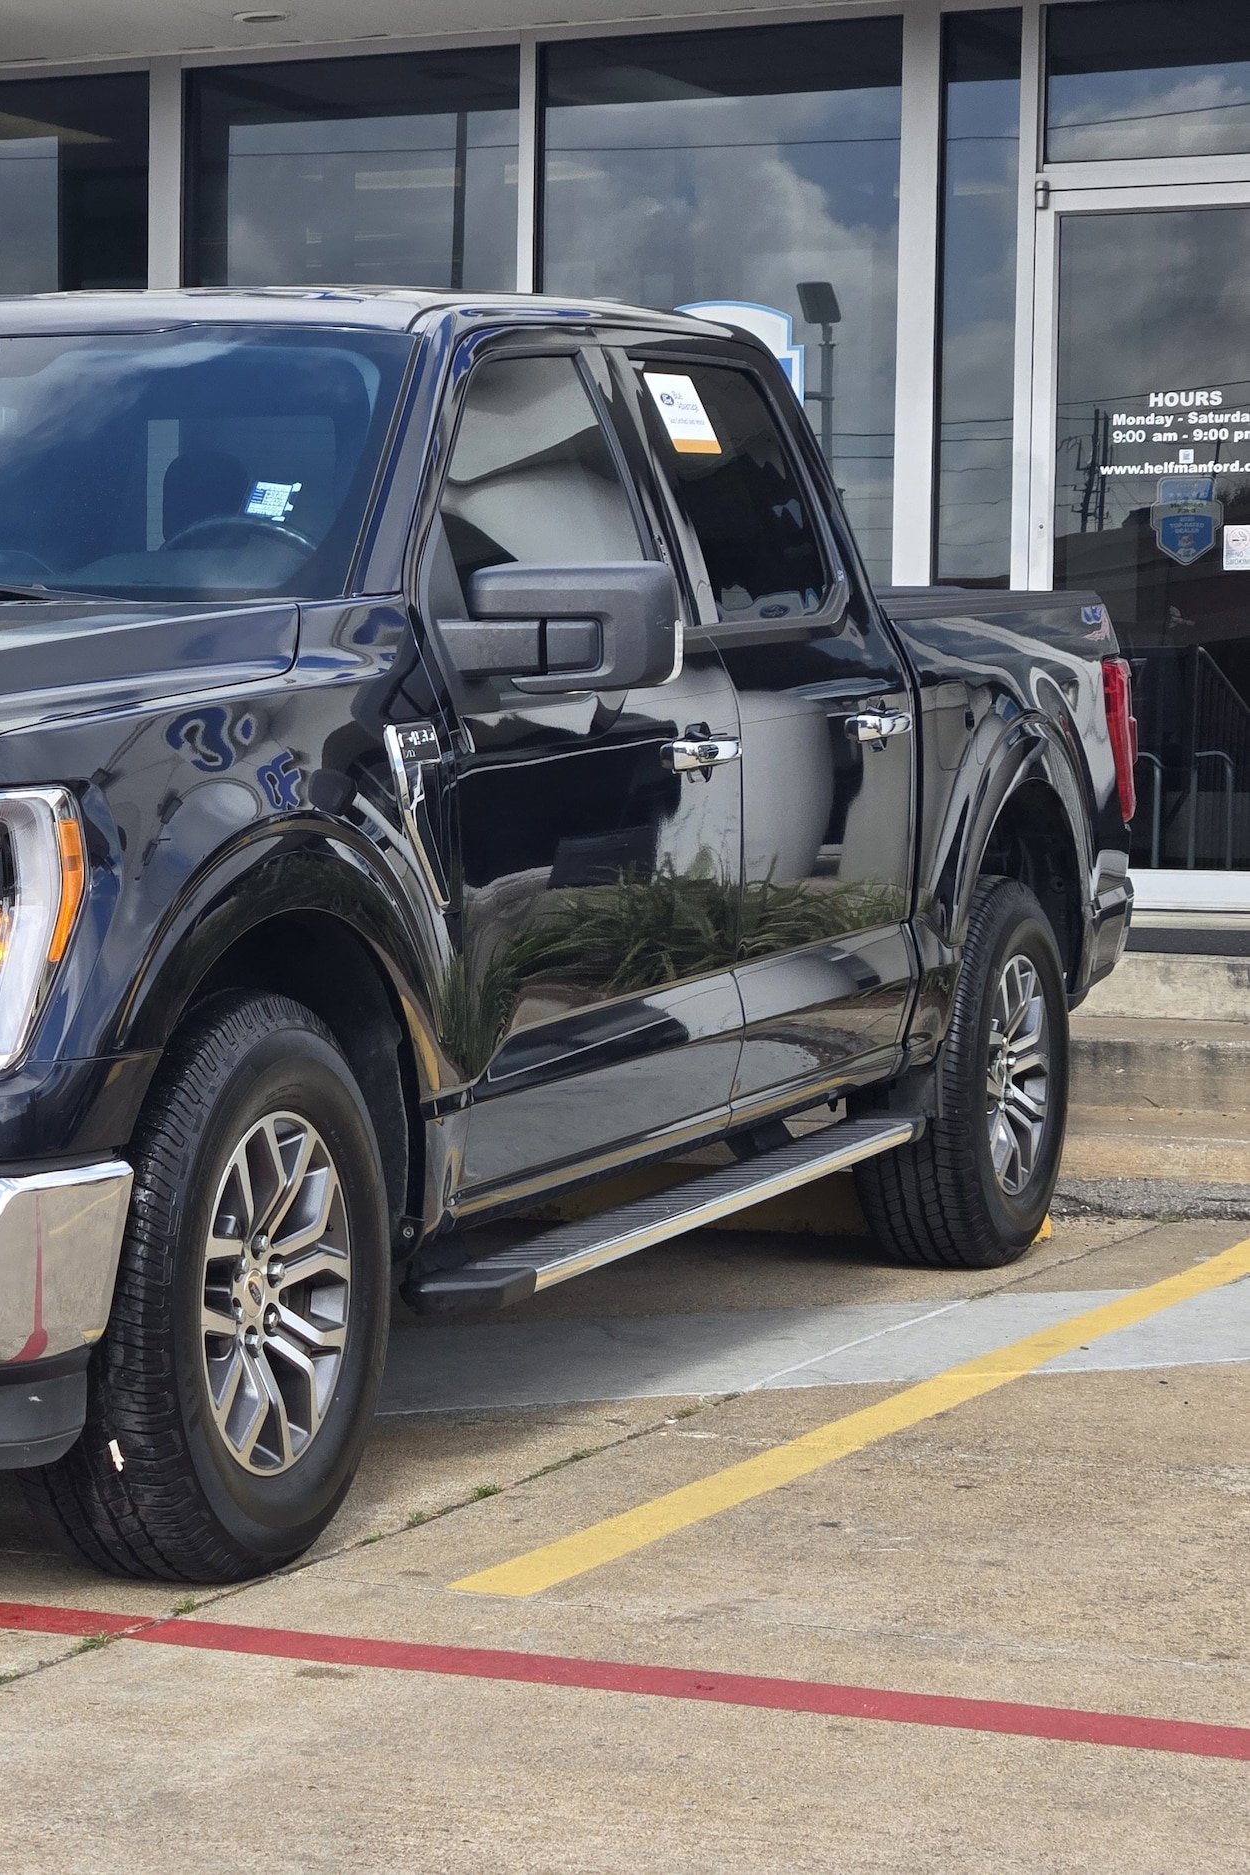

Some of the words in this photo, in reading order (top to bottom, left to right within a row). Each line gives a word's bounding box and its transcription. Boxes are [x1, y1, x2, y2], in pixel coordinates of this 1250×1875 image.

[1149, 390, 1223, 408] HOURS
[1112, 412, 1174, 428] Monday
[1187, 410, 1250, 425] Saturda
[1112, 429, 1146, 443] 9:00
[1152, 432, 1179, 442] am
[1192, 428, 1229, 441] 9:00
